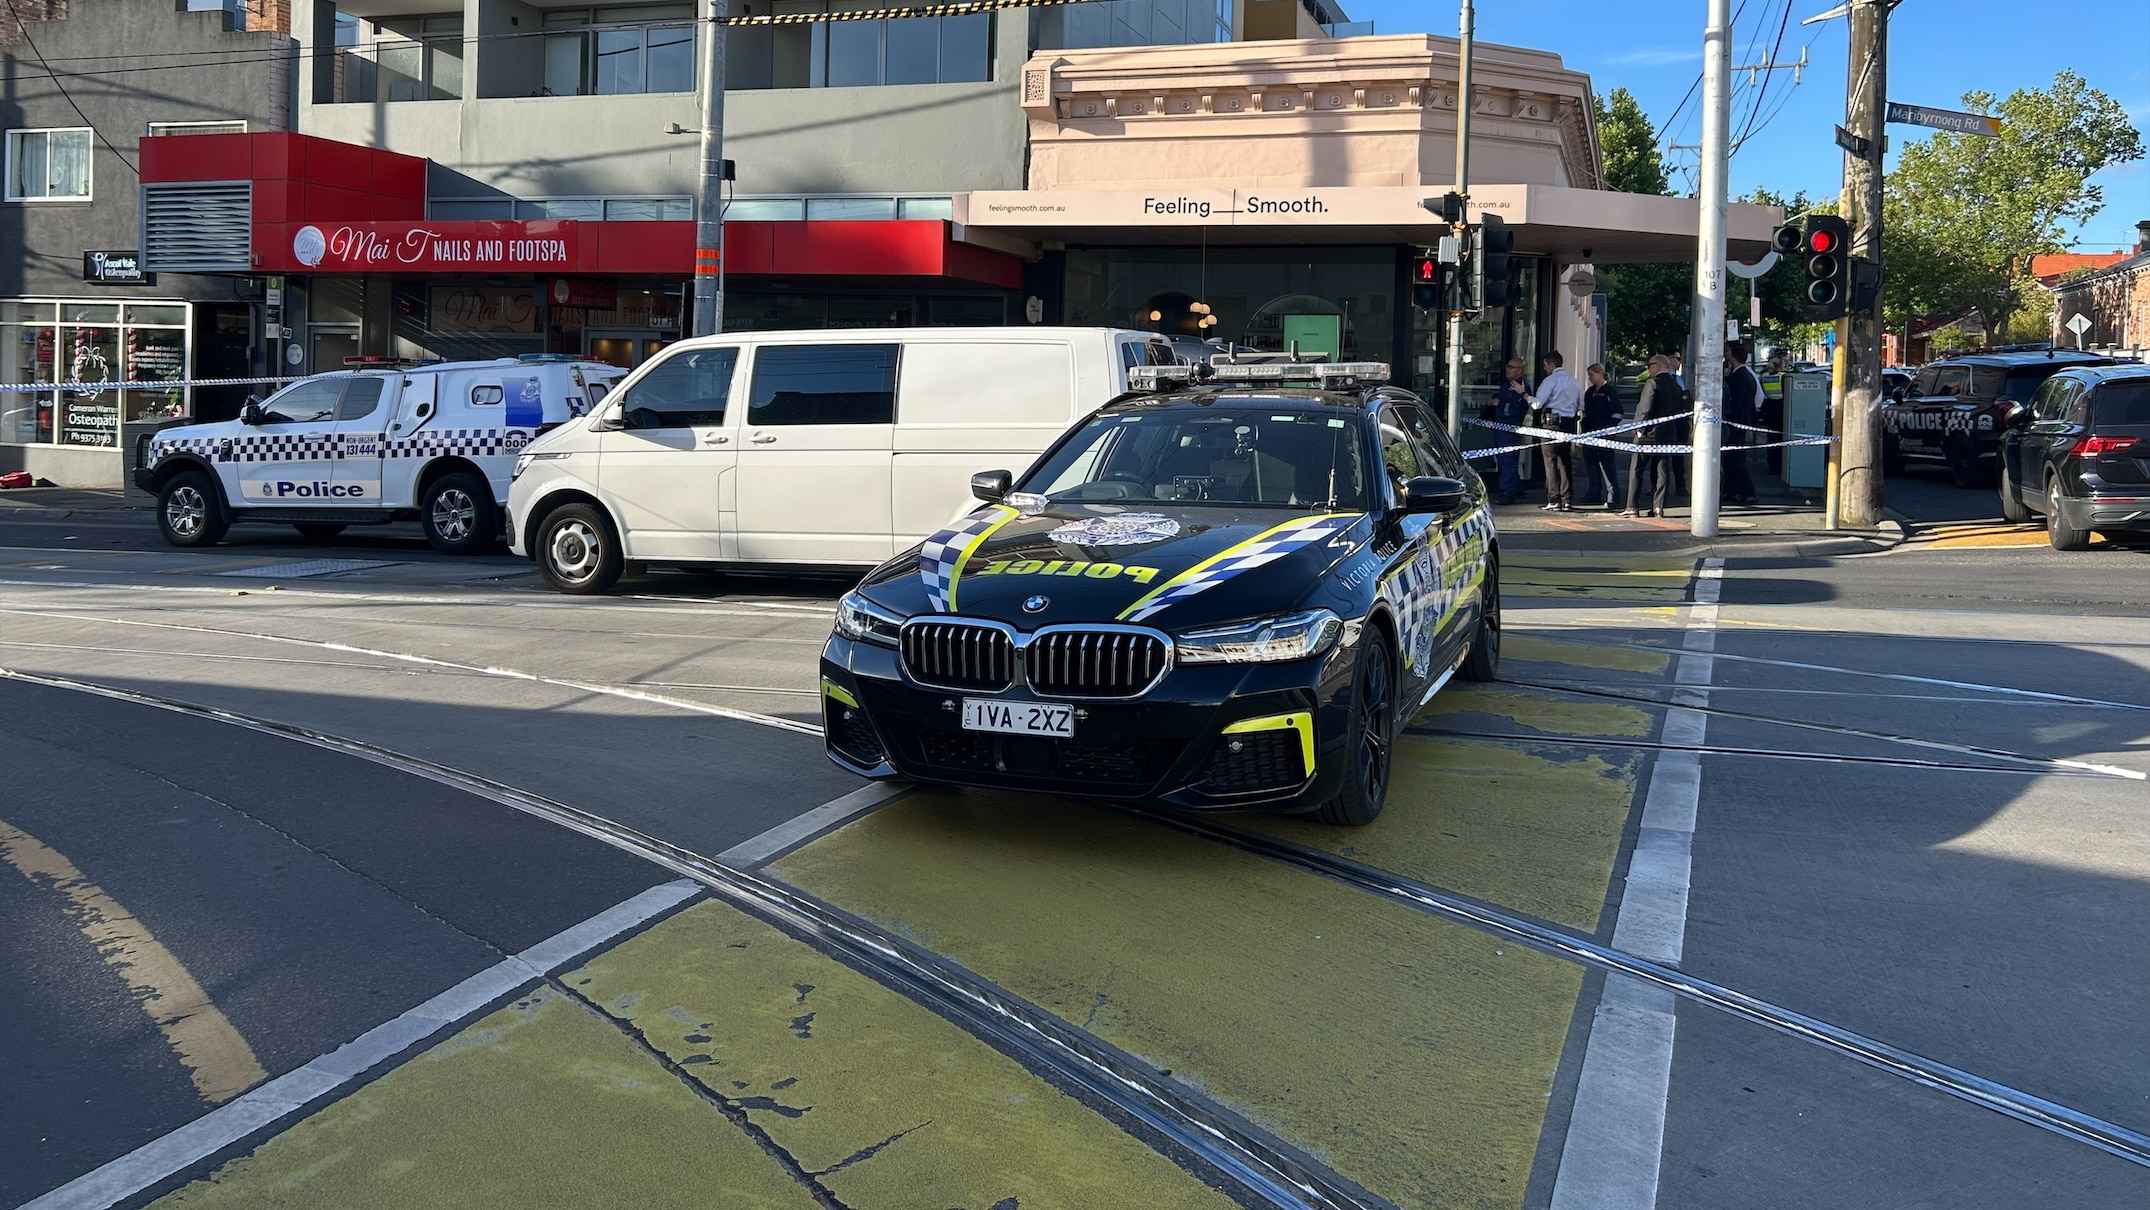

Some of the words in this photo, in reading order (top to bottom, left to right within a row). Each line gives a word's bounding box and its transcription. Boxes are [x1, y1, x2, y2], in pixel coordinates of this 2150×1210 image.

[1891, 107, 1961, 130] Maribyrnong
[1964, 117, 1980, 131] Rd
[989, 204, 1066, 213] feelingsmooth.com.au
[1144, 197, 1211, 218] Feeling
[1247, 196, 1329, 213] Smooth.
[330, 226, 390, 263] Mai
[396, 228, 441, 263] T
[433, 239, 471, 261] NAILS
[475, 239, 502, 261] AND
[508, 239, 567, 262] FOOTSPA
[69, 404, 96, 412] Cameron
[1900, 412, 1943, 430] POLICE
[346, 436, 376, 444] NON-URGENT
[505, 439, 527, 448] 000
[346, 444, 358, 455] 131
[359, 444, 376, 455] 444
[277, 481, 364, 497] Police
[1341, 558, 1377, 591] VICTORIA
[1374, 540, 1398, 564] POLICE
